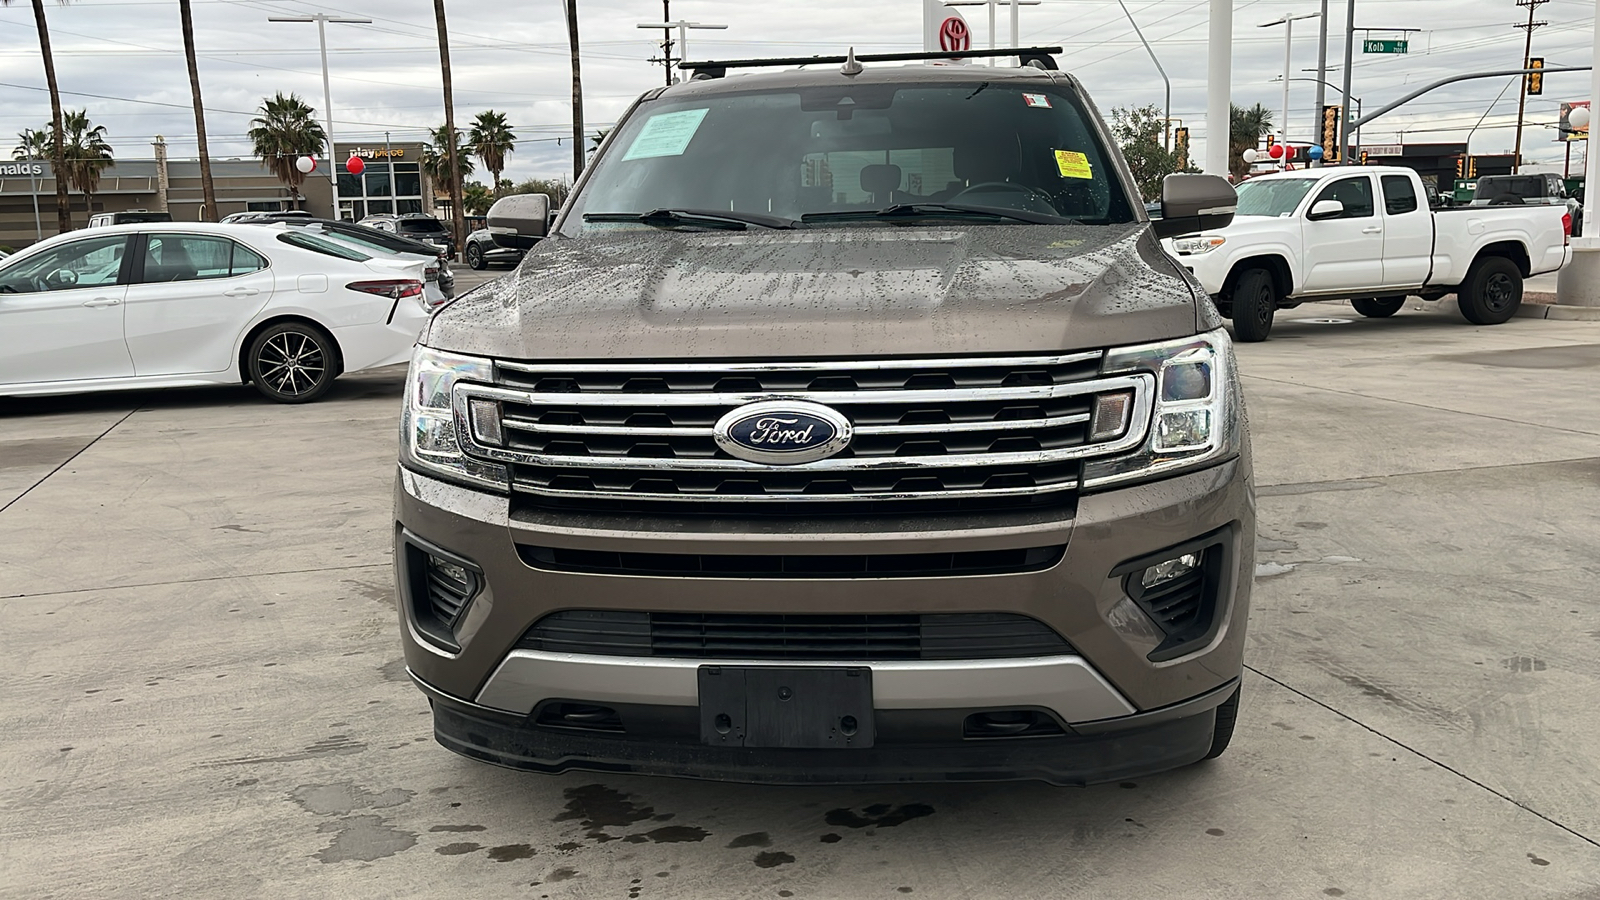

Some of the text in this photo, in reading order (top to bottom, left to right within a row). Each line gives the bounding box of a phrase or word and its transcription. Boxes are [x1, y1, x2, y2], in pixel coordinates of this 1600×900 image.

[1368, 41, 1384, 52] Kolb
[0, 163, 42, 175] nalds
[750, 417, 815, 444] Ford
